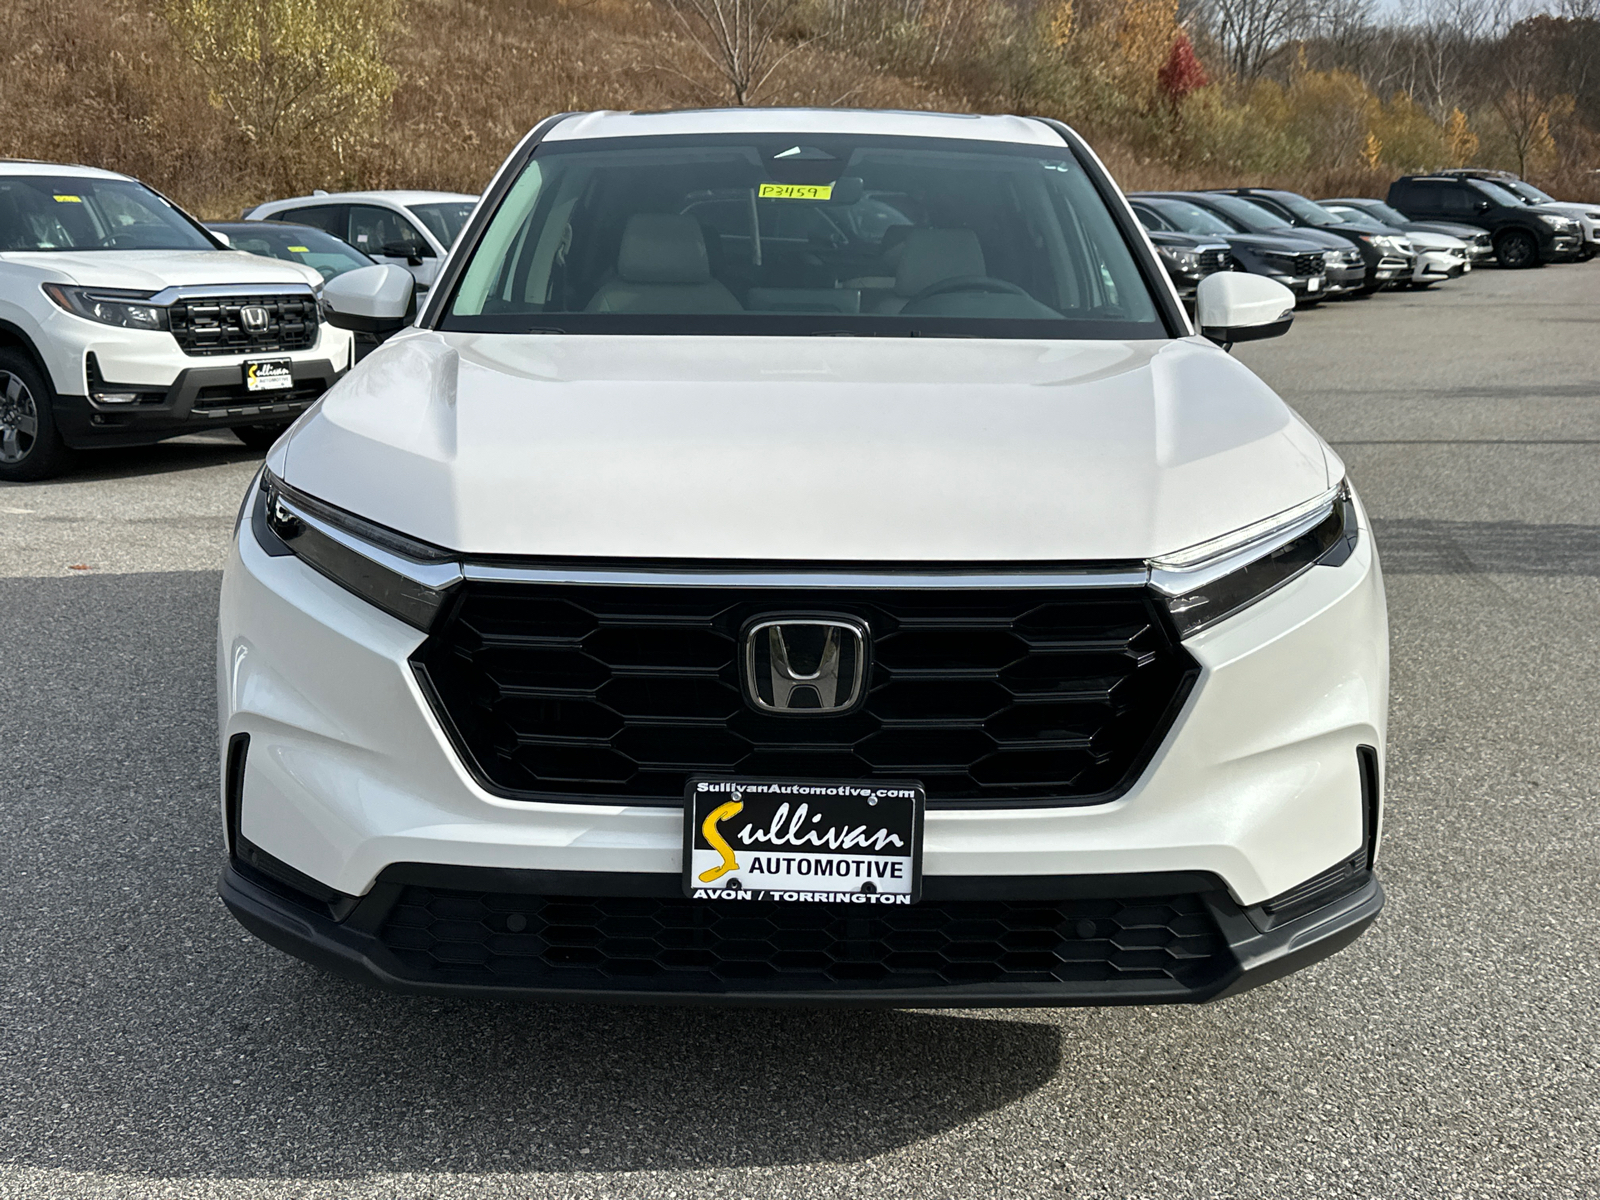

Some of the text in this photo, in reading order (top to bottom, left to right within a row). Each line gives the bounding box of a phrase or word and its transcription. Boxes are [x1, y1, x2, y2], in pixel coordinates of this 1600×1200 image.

[762, 186, 818, 198] P3459
[696, 782, 915, 798] SullivanAutomotive.com
[698, 800, 904, 883] Sullivan
[748, 857, 903, 879] AUTOMOTIVE
[692, 889, 751, 900] AVON
[770, 891, 911, 905] TORRINGTON
